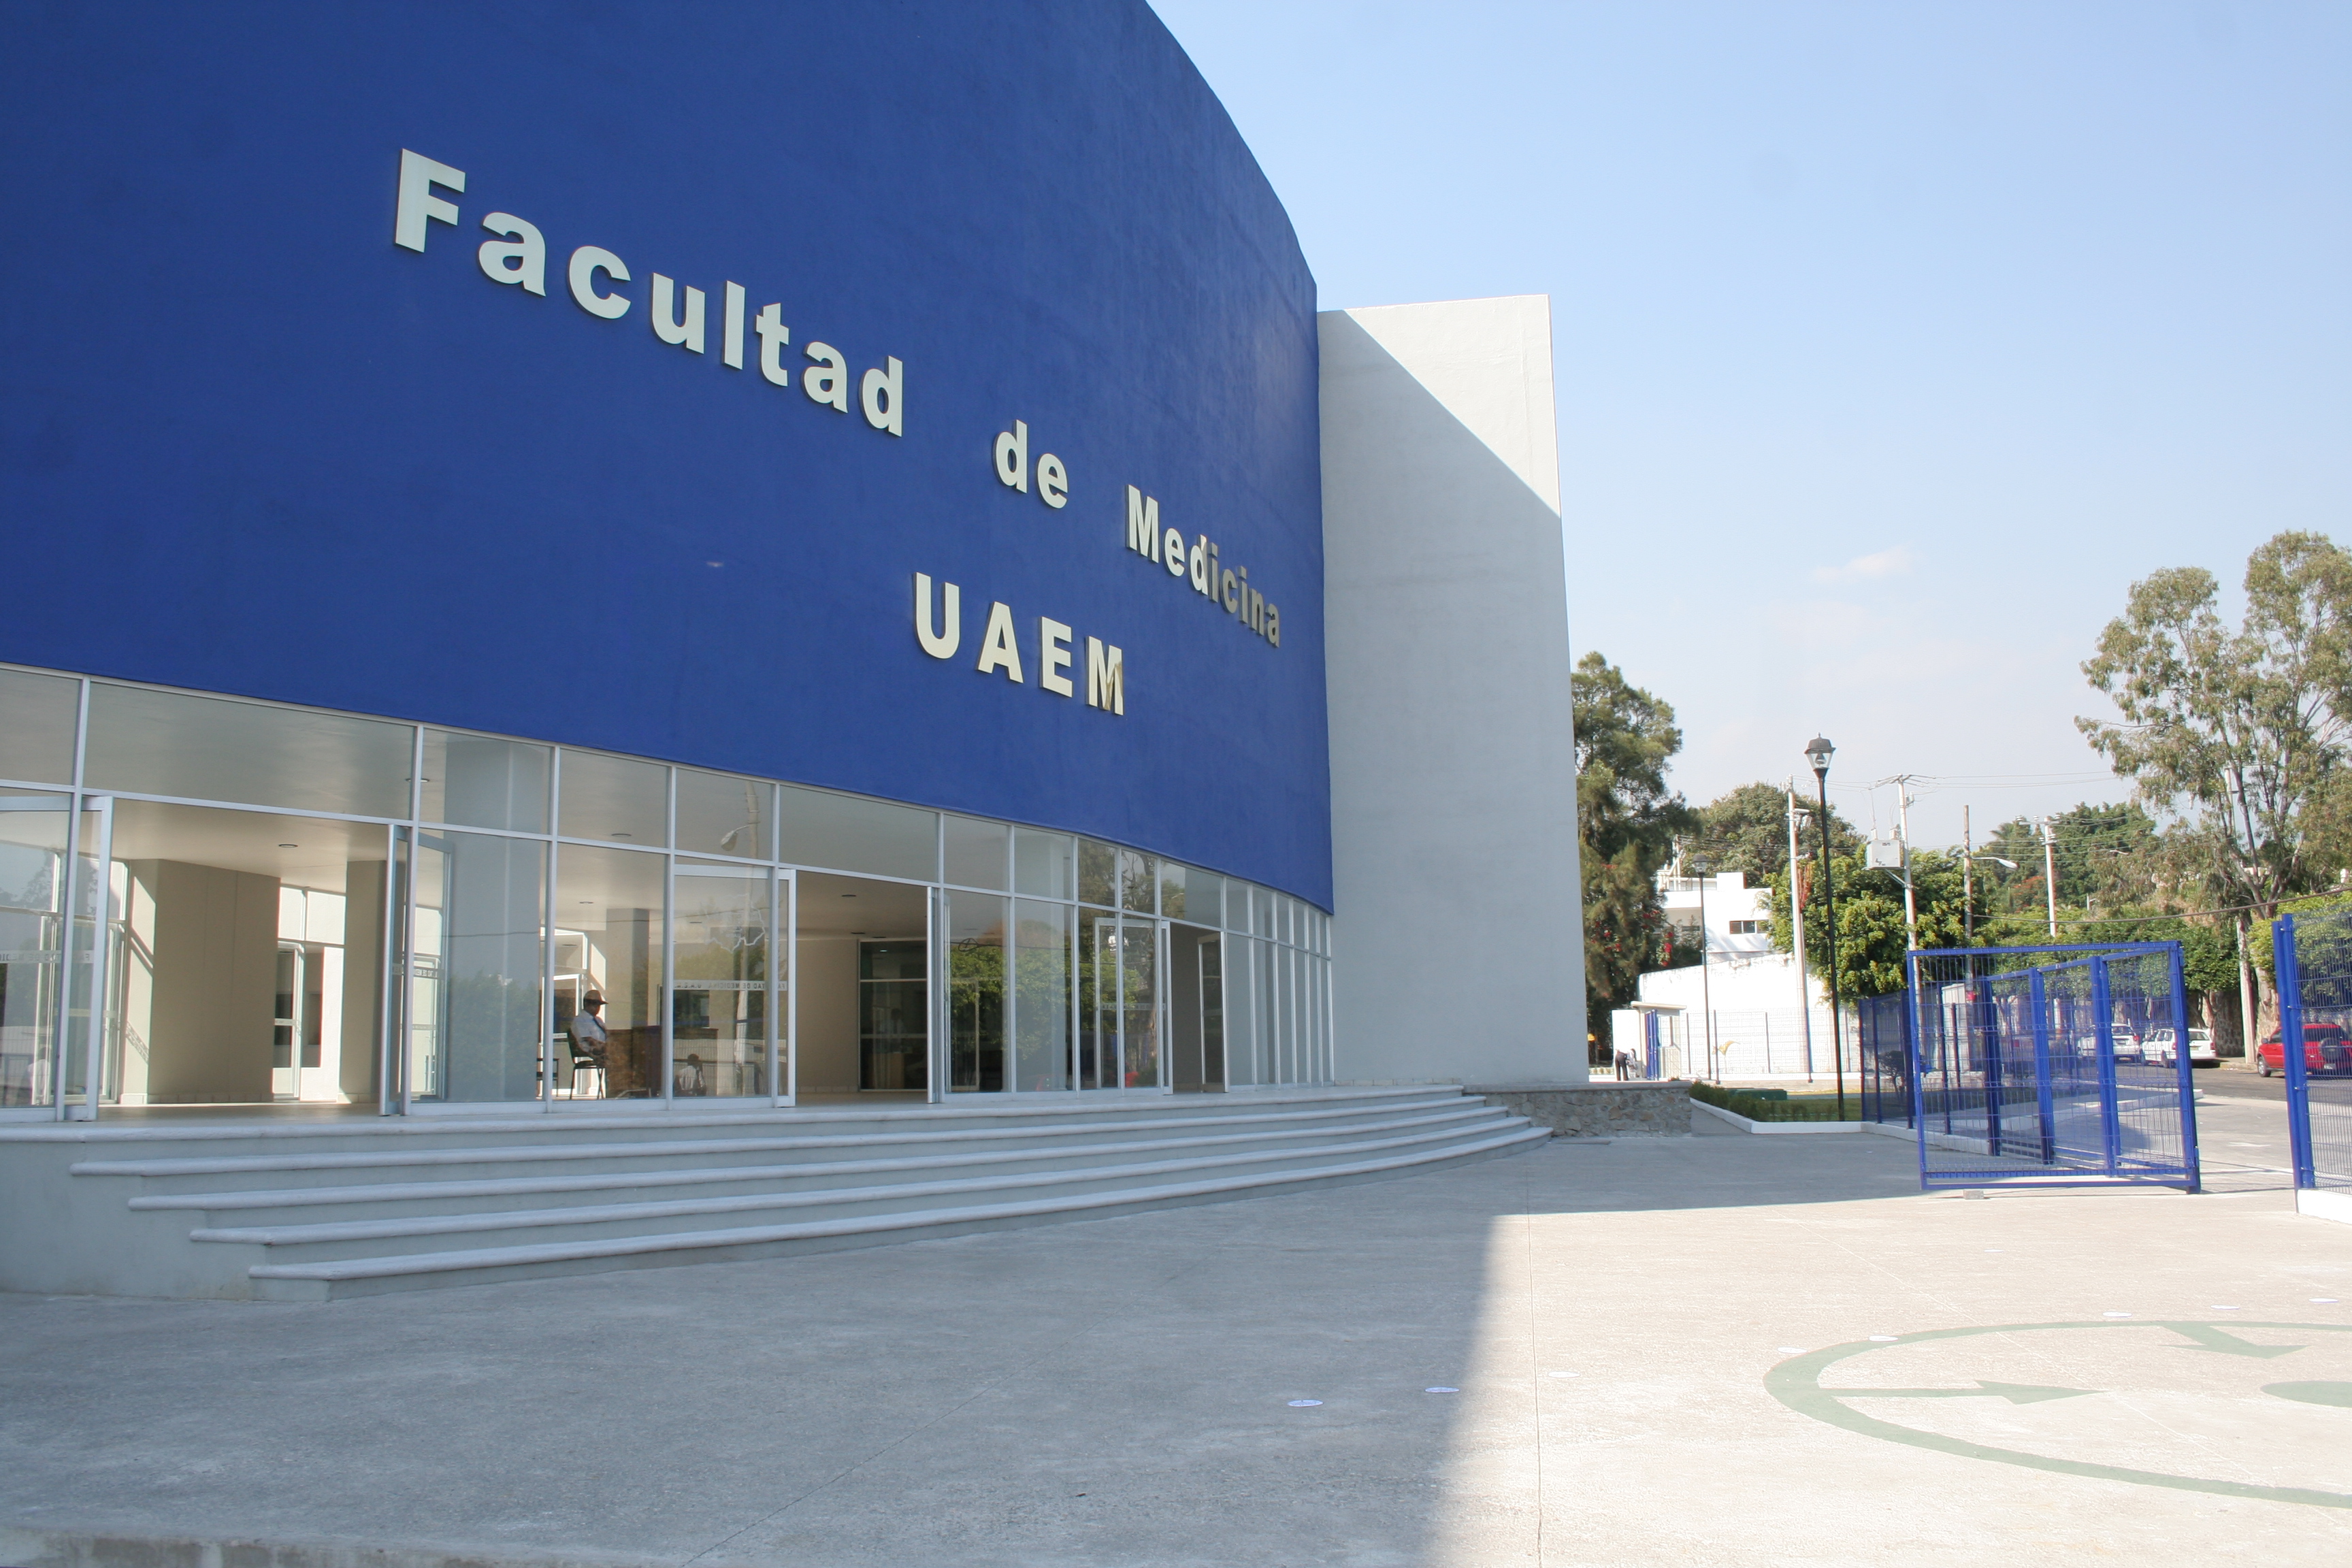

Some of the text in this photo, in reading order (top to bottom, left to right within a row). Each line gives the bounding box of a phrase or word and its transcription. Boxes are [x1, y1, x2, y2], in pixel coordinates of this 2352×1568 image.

[395, 148, 1279, 648] Facultad de Medicina
[913, 572, 1124, 716] UAEM
